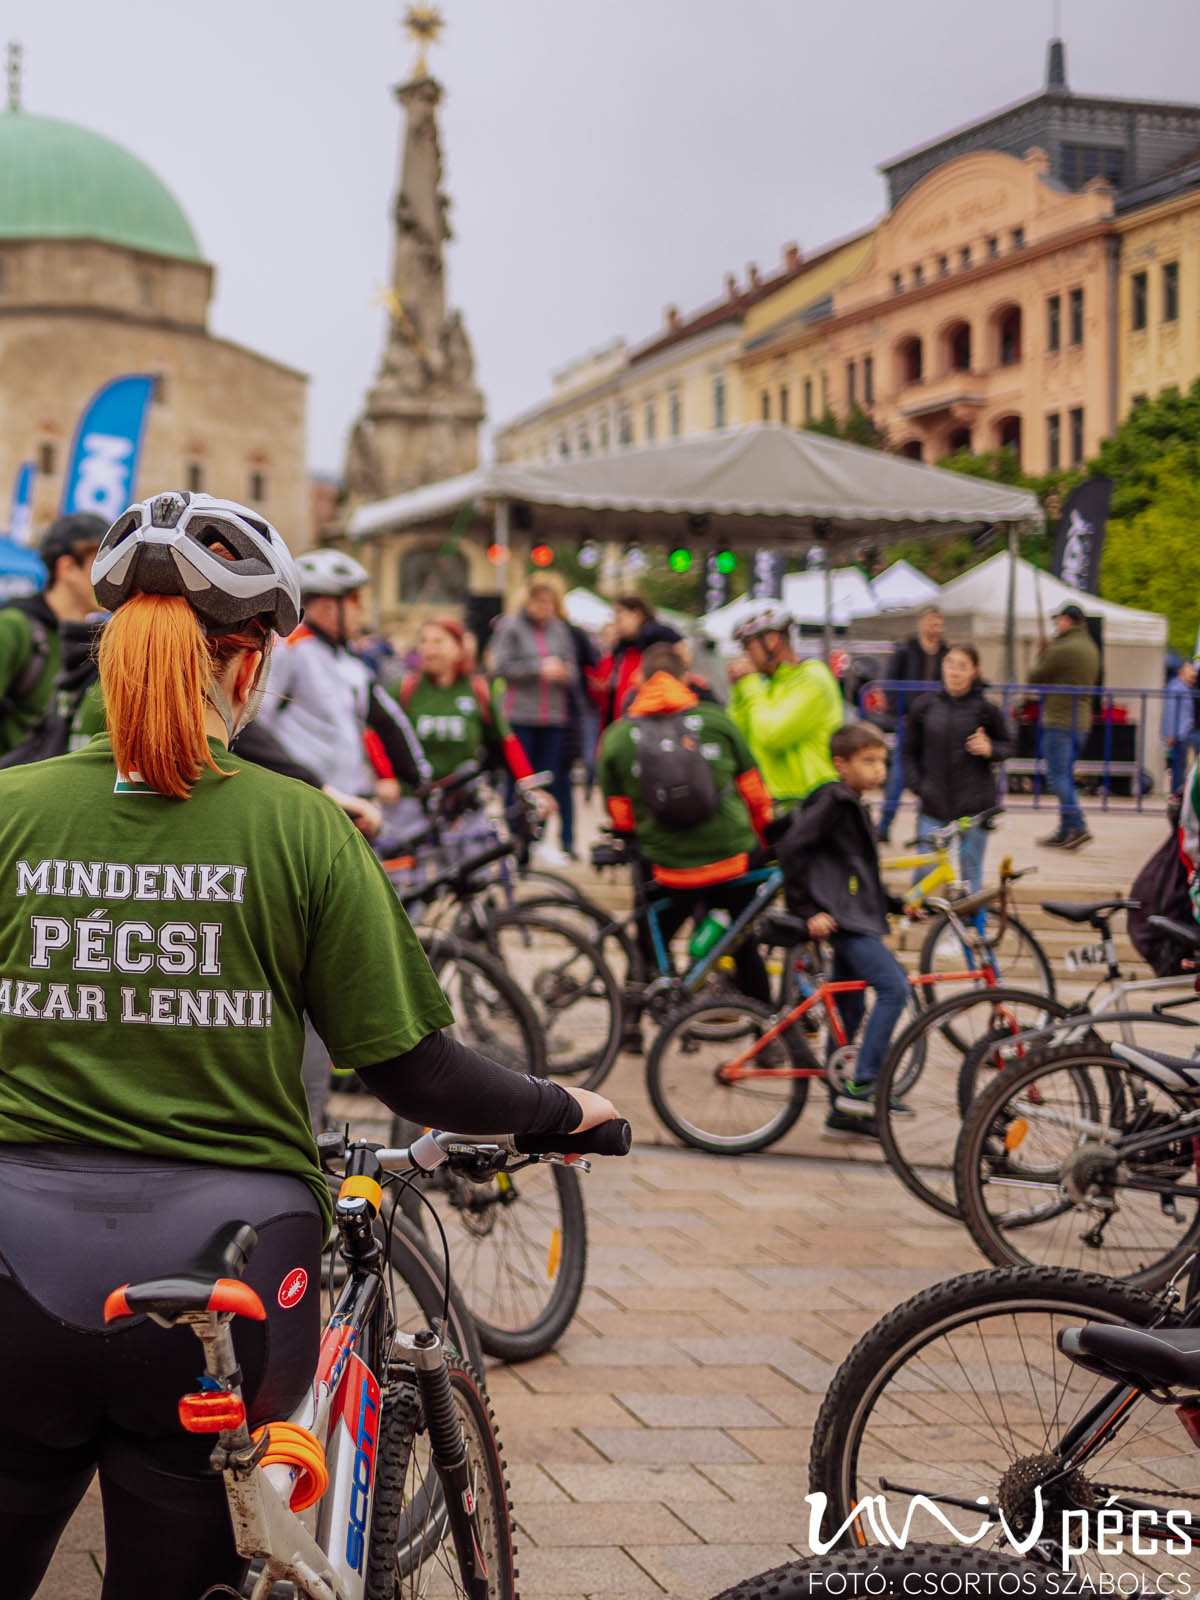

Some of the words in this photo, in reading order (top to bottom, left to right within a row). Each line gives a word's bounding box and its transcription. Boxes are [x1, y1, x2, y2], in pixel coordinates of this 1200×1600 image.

[16, 859, 248, 903] MINDENKI
[30, 908, 223, 976] PÉCSI
[121, 986, 273, 1027] LENNI!
[345, 1378, 377, 1578] SCOTT
